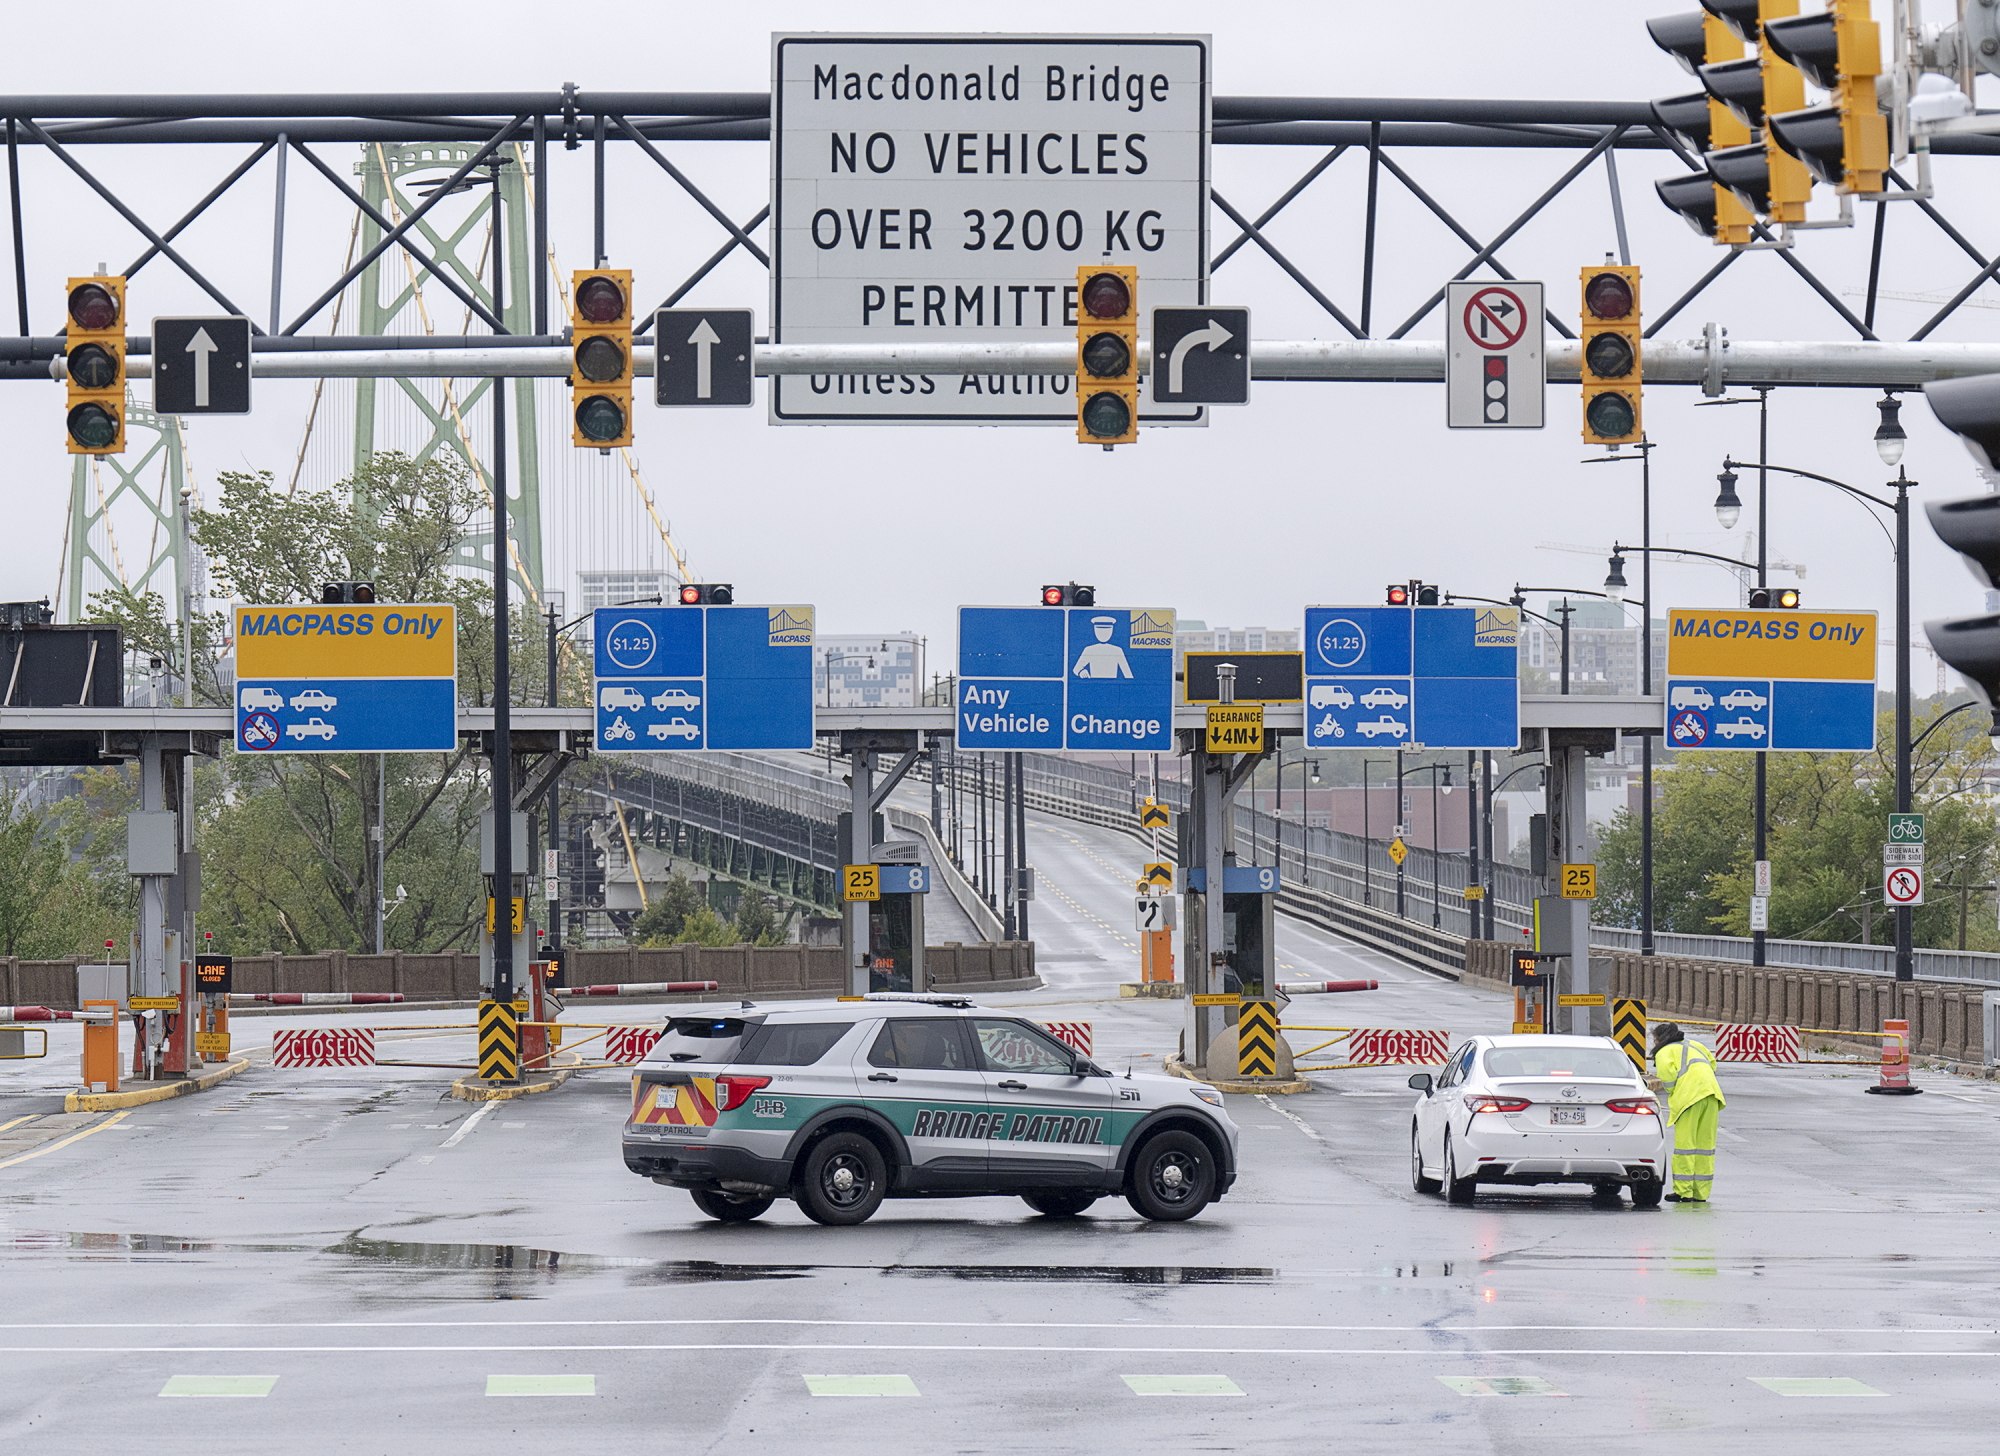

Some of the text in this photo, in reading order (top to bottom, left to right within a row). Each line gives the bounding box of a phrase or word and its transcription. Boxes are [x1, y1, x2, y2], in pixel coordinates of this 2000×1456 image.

[813, 64, 1169, 112] Macdonald Bridge
[830, 132, 1148, 174] NO VEHICLES
[811, 208, 1165, 251] OVER 3200 KG
[862, 285, 1079, 327] PERMITTE
[240, 612, 443, 640] MACPASS Only
[1673, 618, 1865, 645] MACPASS Only
[613, 637, 650, 651] $1.25
[770, 634, 811, 643] MACPASS
[1132, 637, 1172, 646] MACPASS
[1324, 636, 1359, 650] $1.25
[1476, 635, 1516, 644] MACPASS
[963, 685, 1010, 709] Any
[963, 713, 1049, 733] Vehicle
[1071, 714, 1160, 739] Change
[1209, 712, 1261, 723] CLEARANCE
[1223, 727, 1248, 744] 4M
[850, 871, 873, 887] 25
[908, 868, 923, 890] 8
[1259, 869, 1274, 890] 9
[1567, 870, 1590, 885] 25
[849, 890, 875, 898] km/h
[1566, 888, 1591, 896] km/h
[198, 965, 225, 975] LANE
[873, 958, 894, 968] ANE
[291, 1037, 358, 1059] CLOSED
[623, 1035, 656, 1055] CLO
[1366, 1037, 1432, 1057] CLOSED
[1729, 1033, 1785, 1054] CLOSED
[1120, 1090, 1141, 1101] 511
[639, 1125, 693, 1135] BRIDGE PATROL
[912, 1109, 1104, 1145] BRIDGE PATROL
